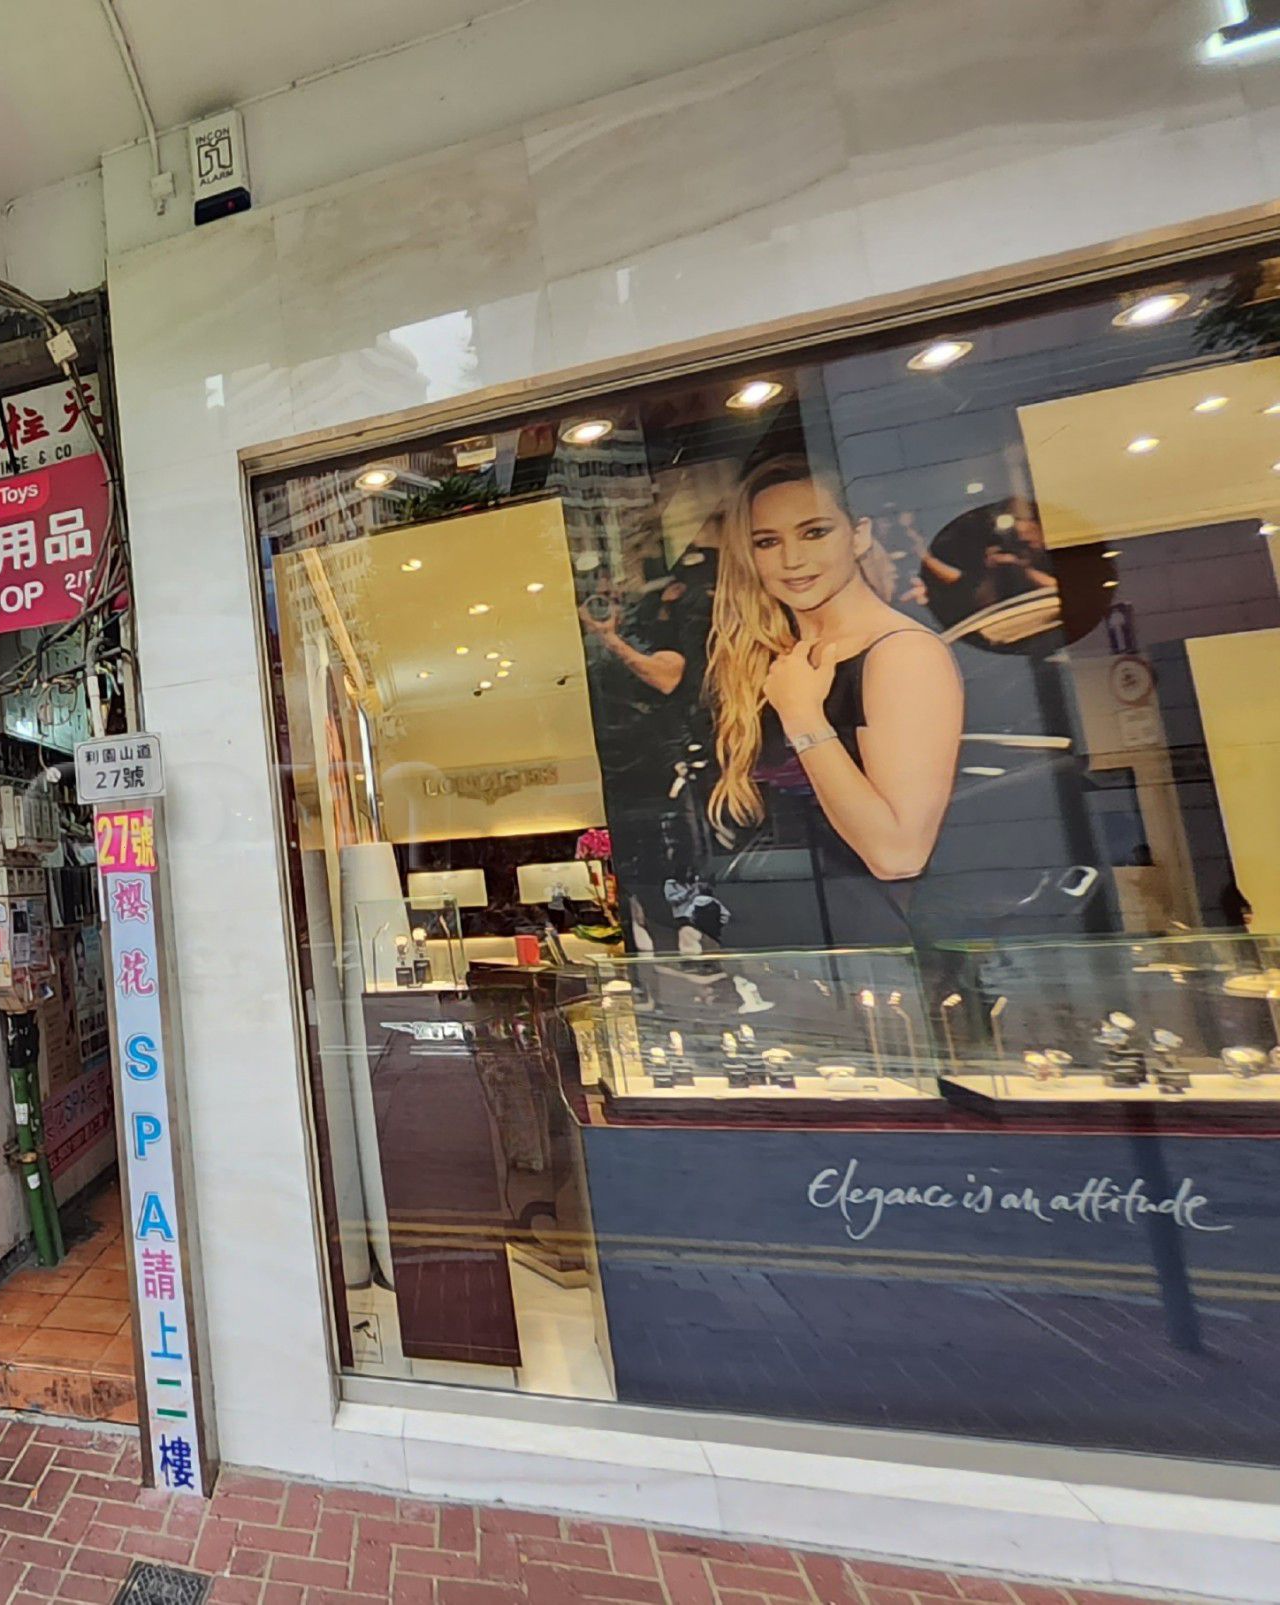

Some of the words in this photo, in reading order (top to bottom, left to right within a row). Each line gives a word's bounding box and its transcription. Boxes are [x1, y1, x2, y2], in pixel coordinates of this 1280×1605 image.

[38, 450, 47, 466] &
[55, 444, 73, 460] CO
[85, 743, 152, 766] 利園山道
[95, 765, 145, 790] 27號
[96, 814, 156, 868] 27號
[807, 1157, 957, 1241] Elegance
[963, 1173, 992, 1214] is
[999, 1186, 1054, 1223] an
[1049, 1176, 1234, 1232] attitude
